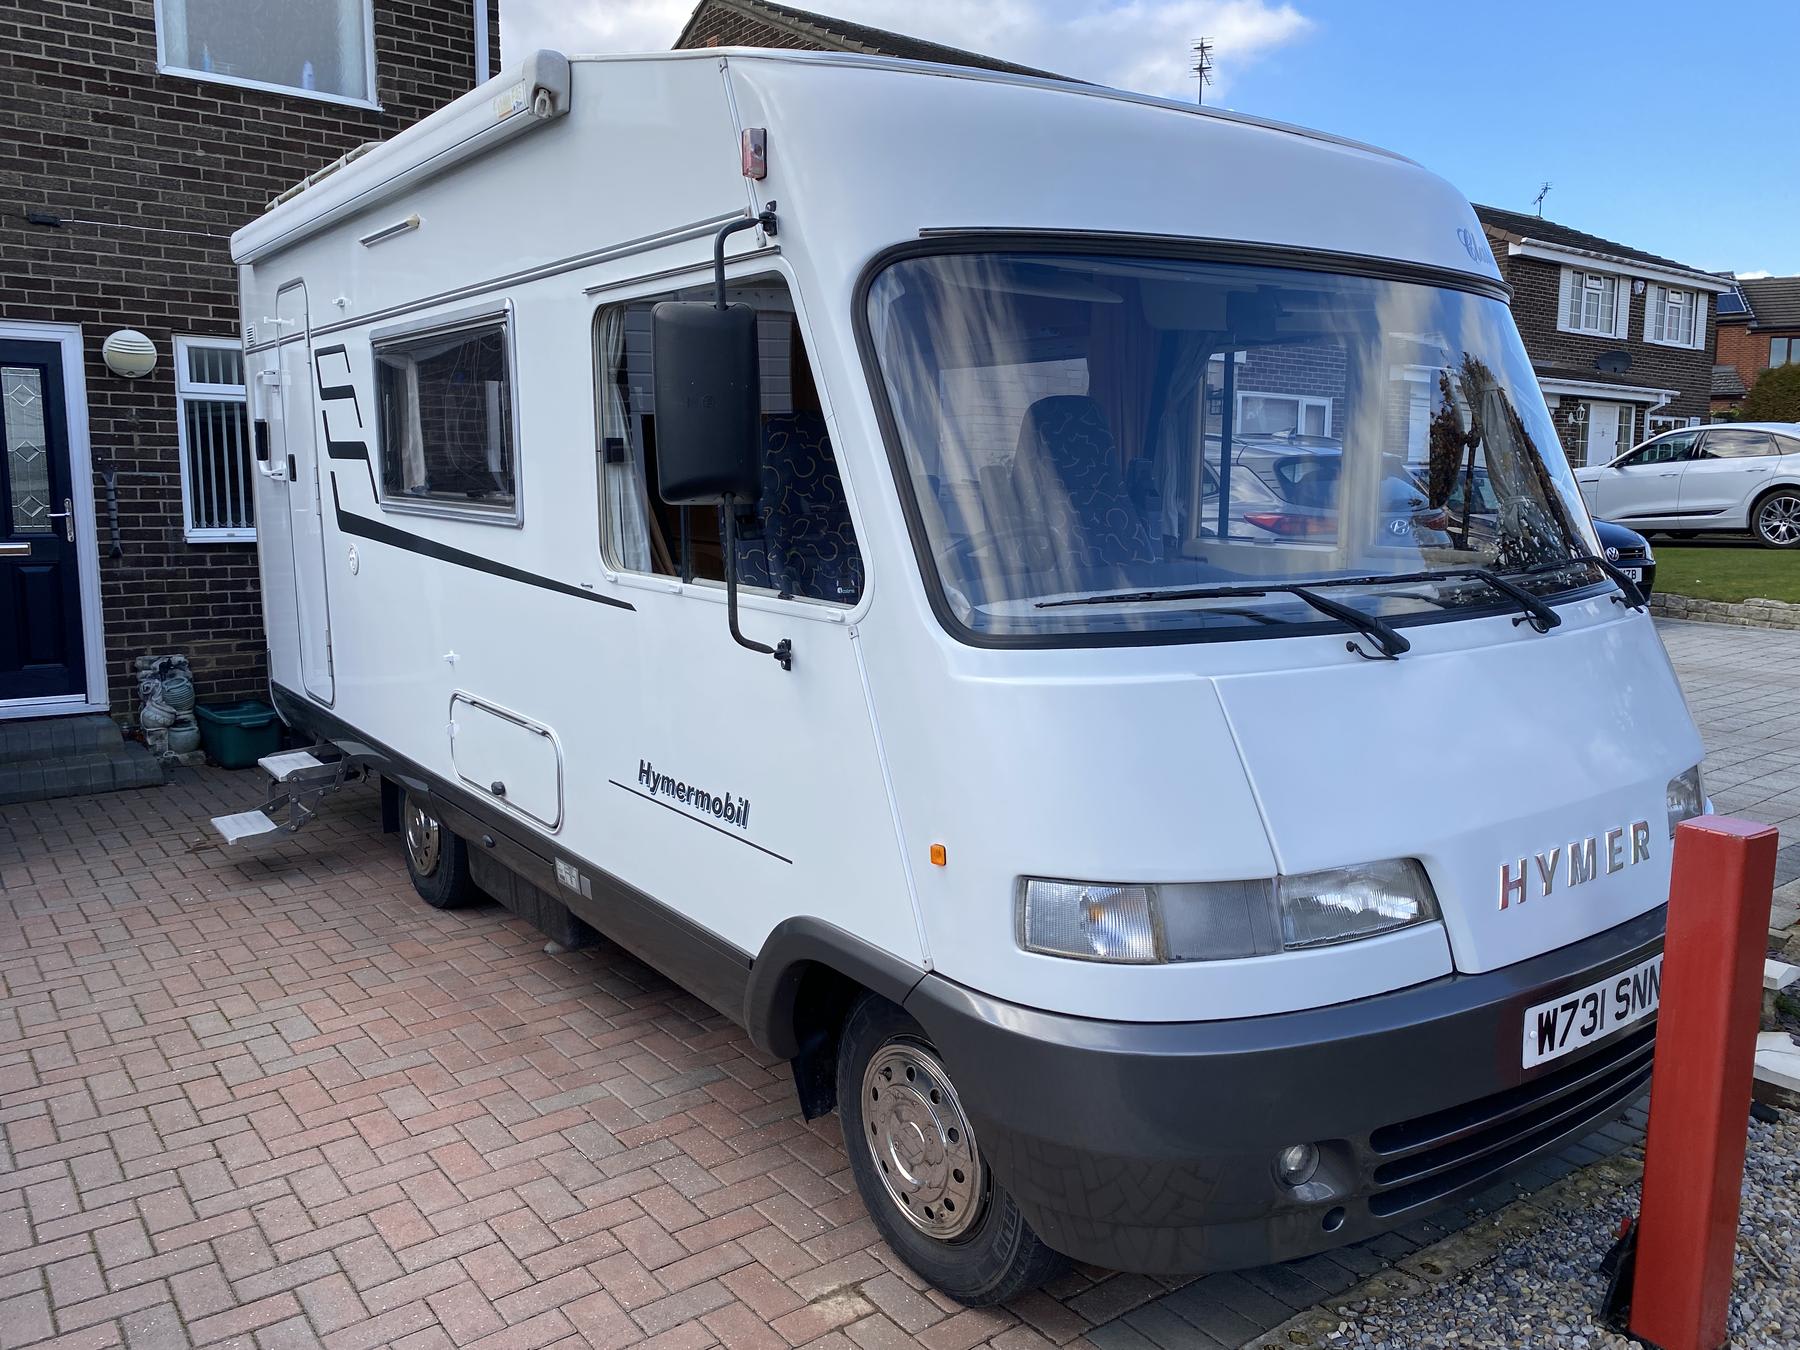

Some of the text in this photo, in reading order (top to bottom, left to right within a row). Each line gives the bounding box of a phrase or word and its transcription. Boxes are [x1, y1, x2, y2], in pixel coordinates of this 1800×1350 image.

[638, 759, 750, 829] Hymermobil
[1499, 820, 1650, 911] HYMER
[1537, 989, 1606, 1056] W731
